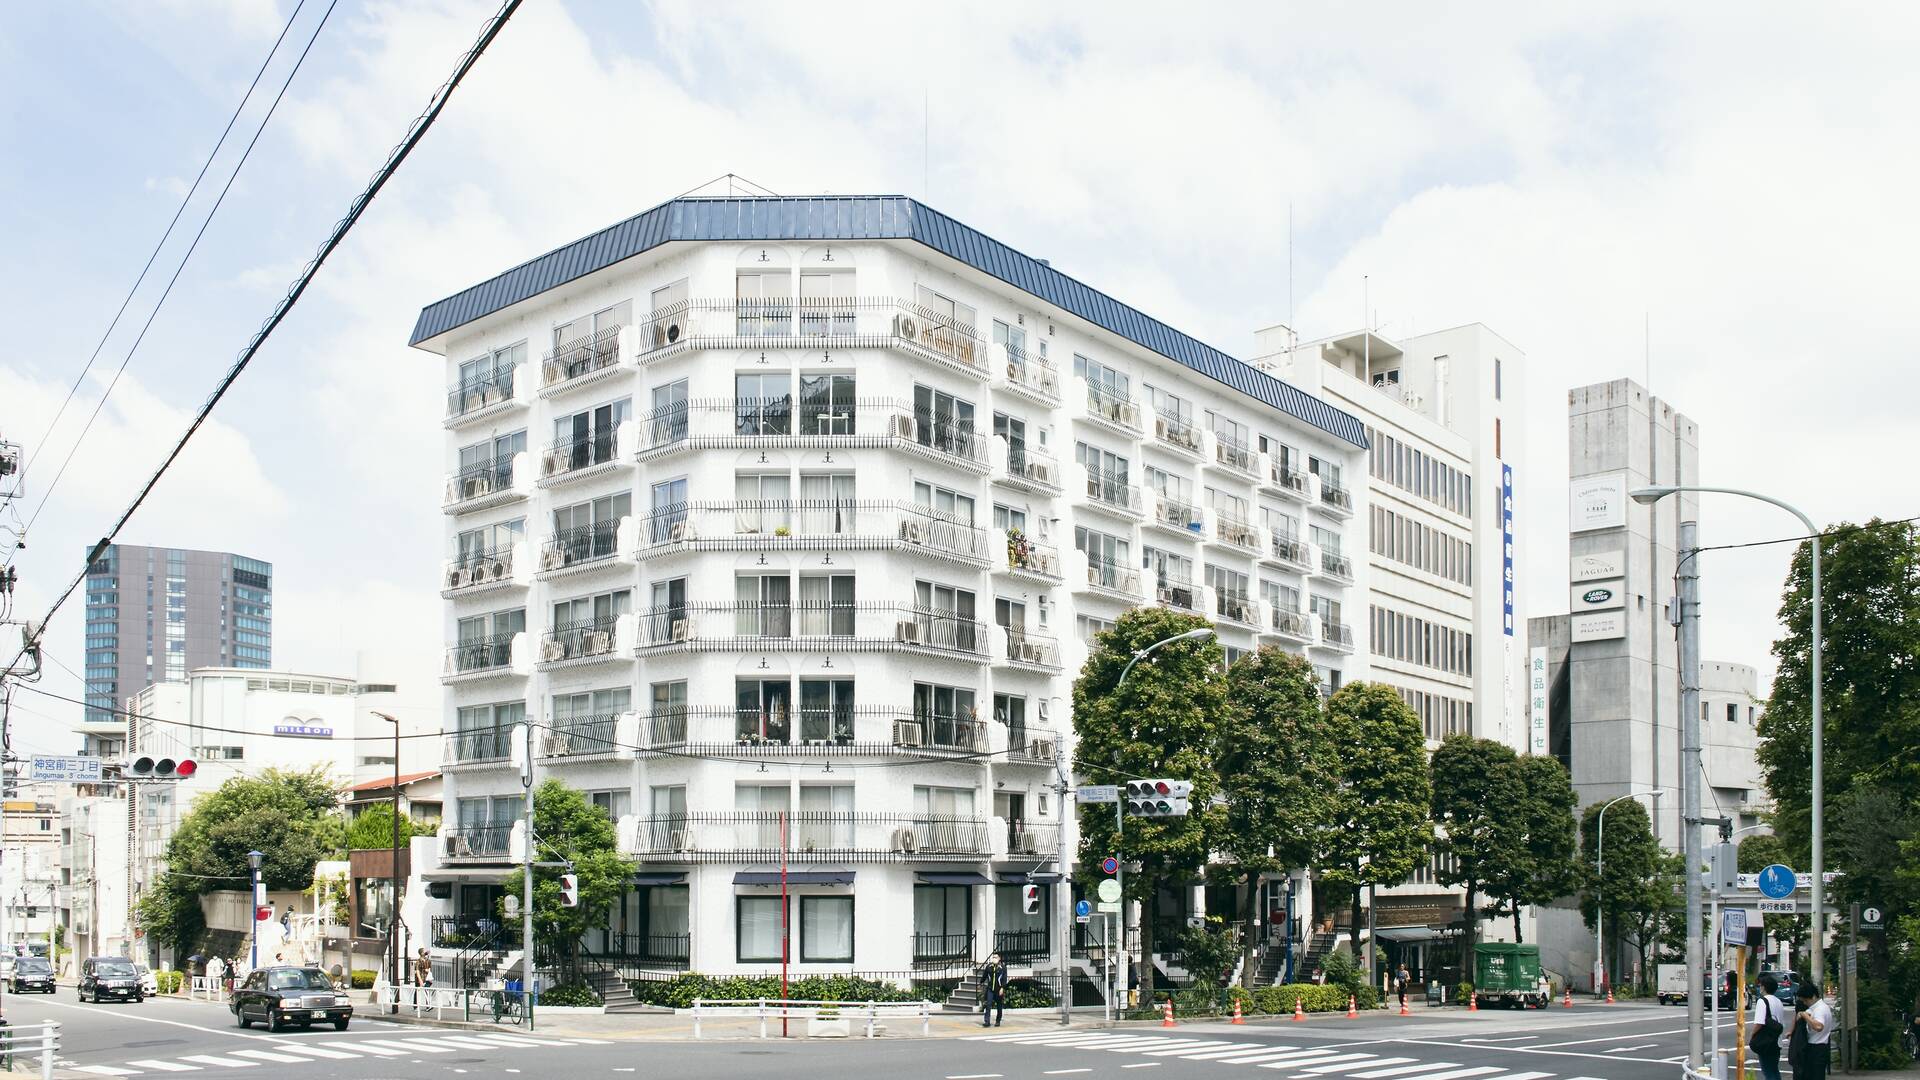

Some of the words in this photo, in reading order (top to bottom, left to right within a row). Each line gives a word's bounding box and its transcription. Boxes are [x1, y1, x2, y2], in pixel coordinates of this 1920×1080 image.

[1579, 566, 1615, 577] JAGUAR
[1589, 594, 1609, 602] ROVER
[34, 759, 99, 772] 神宮前三丁目
[1760, 903, 1793, 911] 歩行者優先
